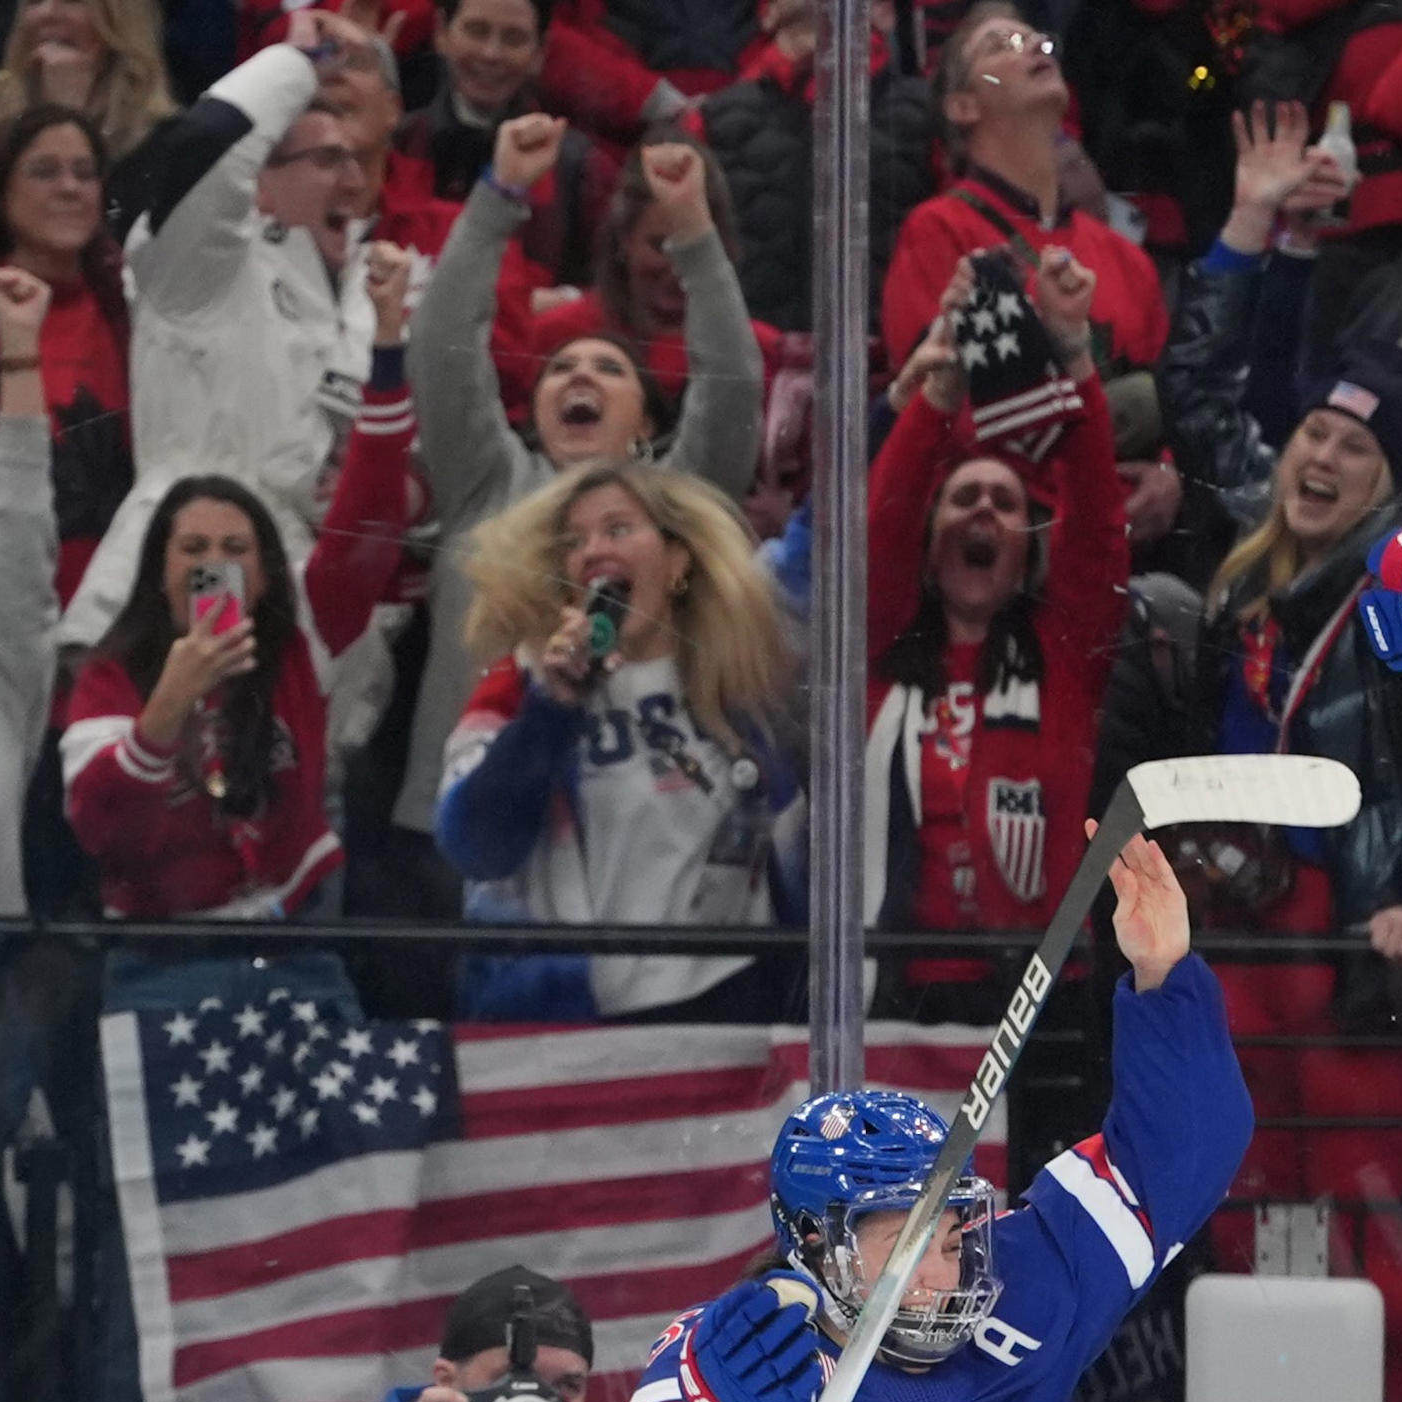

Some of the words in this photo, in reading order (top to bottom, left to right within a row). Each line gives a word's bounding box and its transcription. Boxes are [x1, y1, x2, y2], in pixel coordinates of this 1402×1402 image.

[587, 693, 698, 767] US
[961, 953, 1052, 1130] BAUER
[974, 1317, 1042, 1367] A
